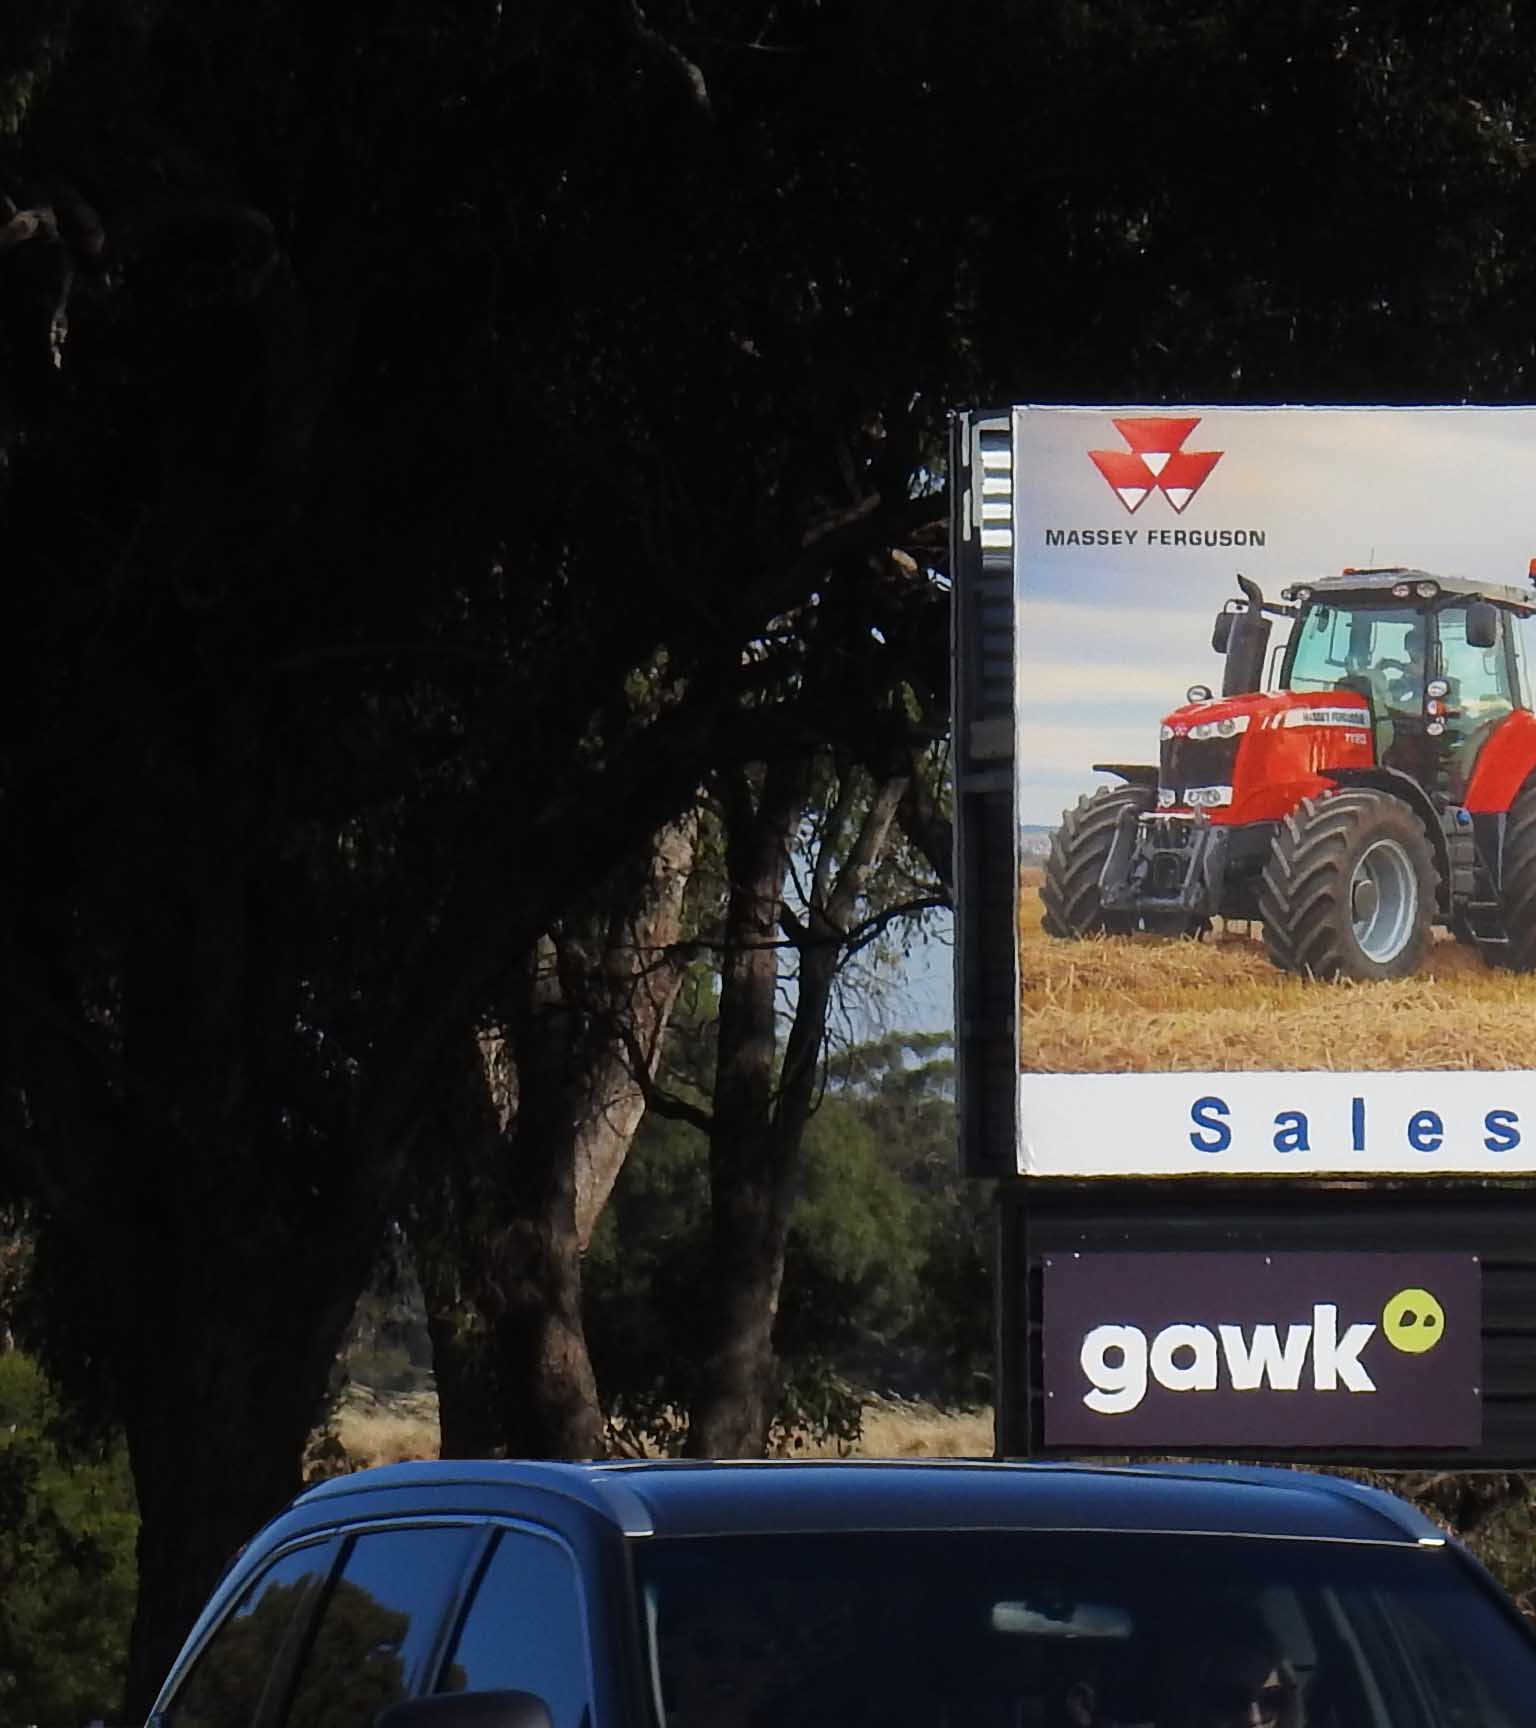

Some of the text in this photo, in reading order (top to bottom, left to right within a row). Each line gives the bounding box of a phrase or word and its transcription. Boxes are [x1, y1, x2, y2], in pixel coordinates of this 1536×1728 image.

[1046, 529, 1267, 547] MASSEY FERGUSON
[1189, 1096, 1522, 1154] Sales
[1080, 1303, 1378, 1415] gawk
